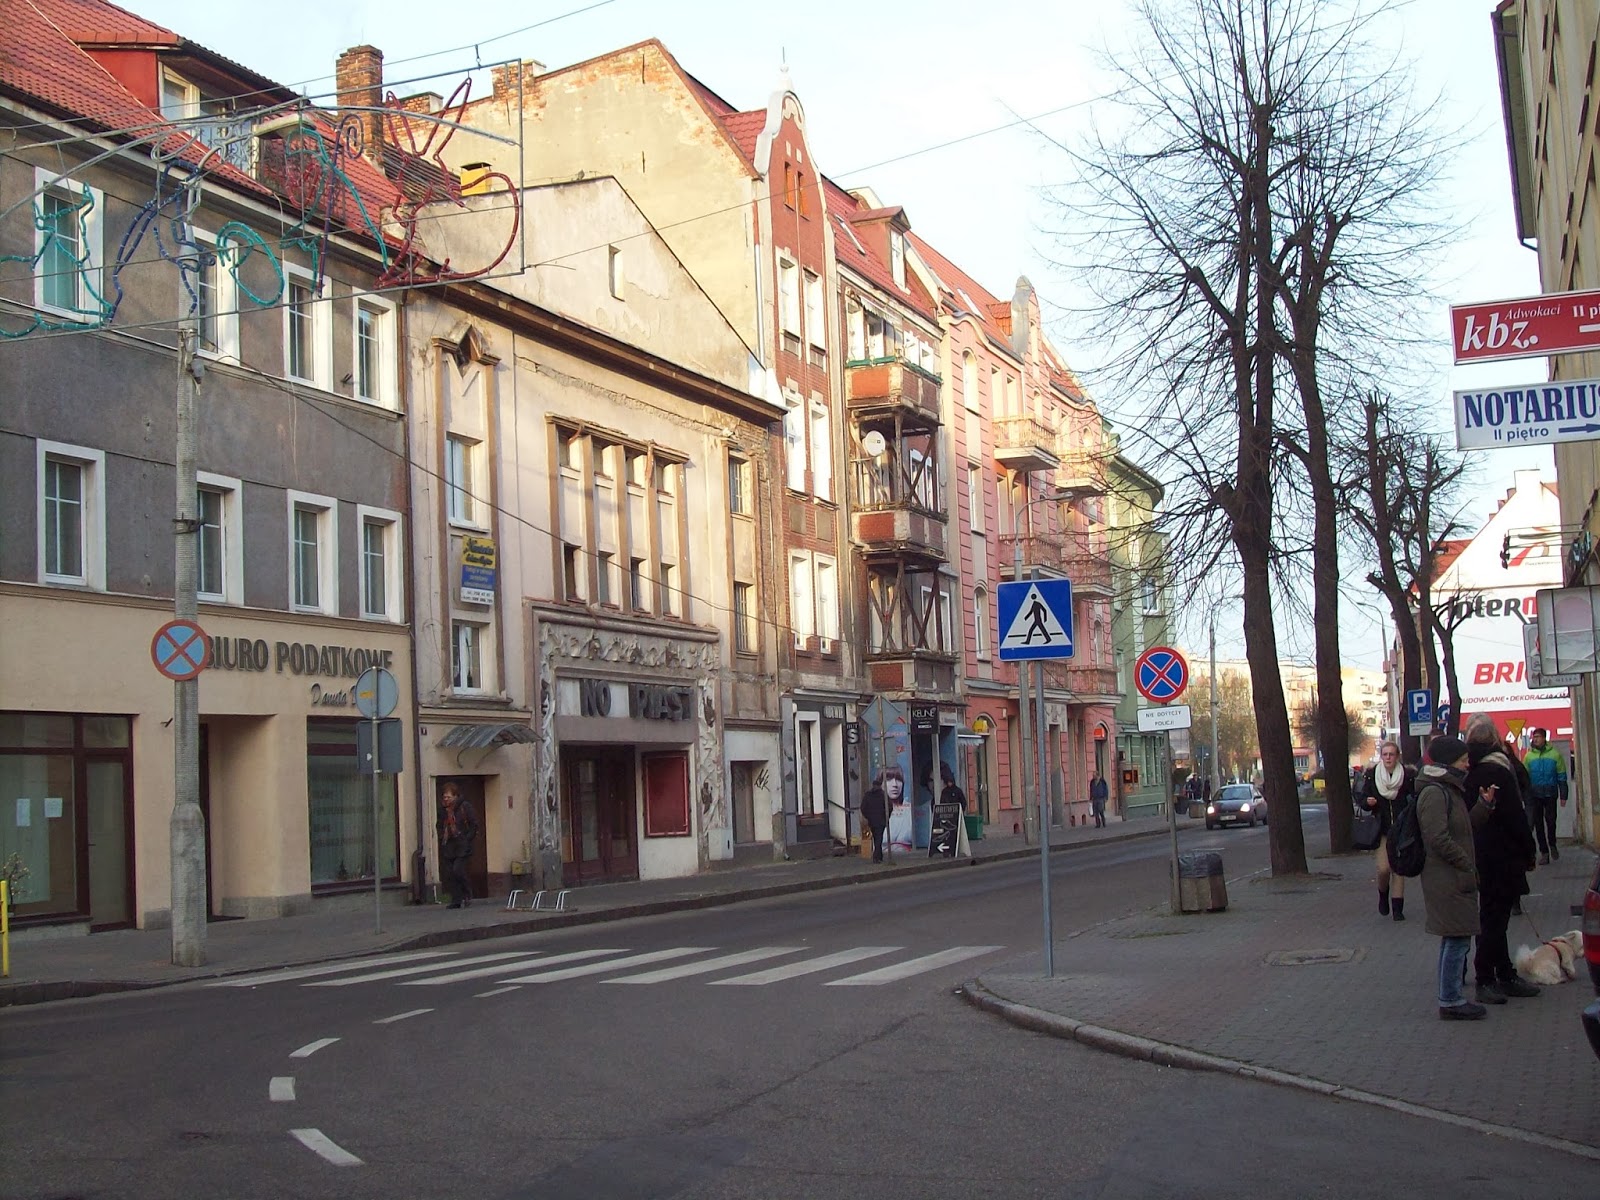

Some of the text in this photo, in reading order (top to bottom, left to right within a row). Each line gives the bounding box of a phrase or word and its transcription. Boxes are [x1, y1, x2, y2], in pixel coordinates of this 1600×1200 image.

[1504, 304, 1561, 320] Adwokaci
[1462, 312, 1539, 351] kbz.
[1463, 384, 1600, 428] NOTARIU
[1507, 427, 1549, 442] piętro
[207, 635, 393, 678] BIURO PODATKOWE
[1474, 661, 1528, 685] BRI
[579, 679, 694, 719] NO PIAST
[1413, 692, 1426, 714] P
[1459, 696, 1504, 704] UDOWLANE
[913, 707, 937, 718] KEUNE
